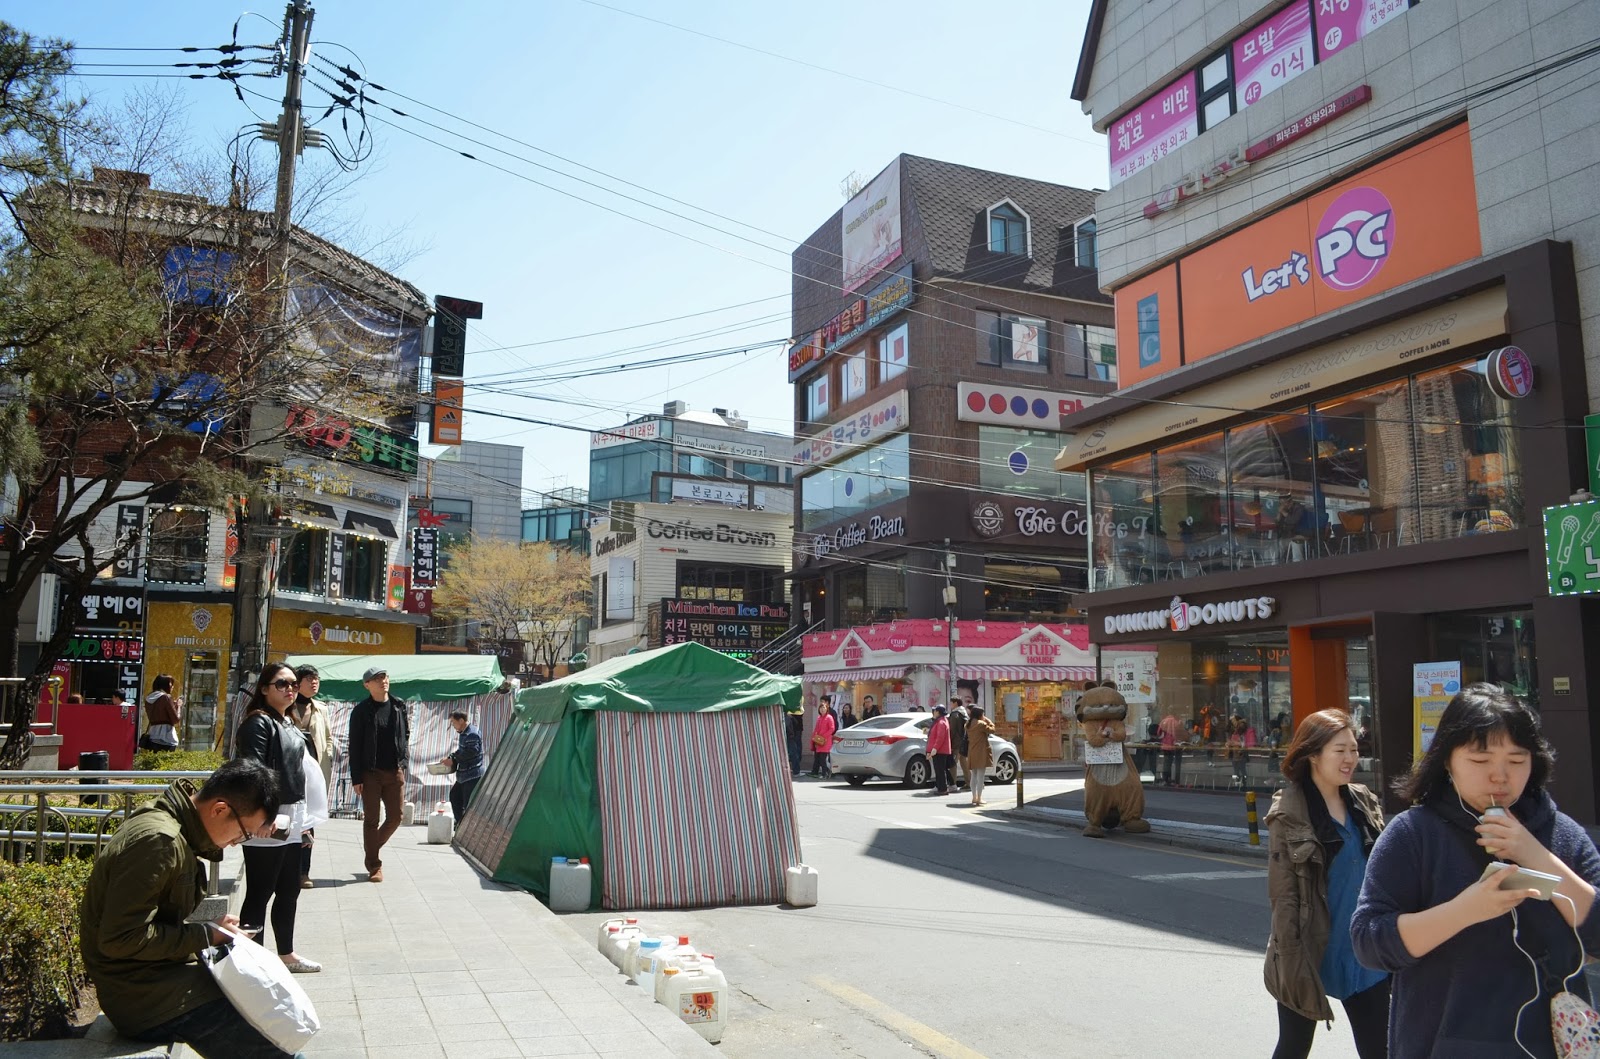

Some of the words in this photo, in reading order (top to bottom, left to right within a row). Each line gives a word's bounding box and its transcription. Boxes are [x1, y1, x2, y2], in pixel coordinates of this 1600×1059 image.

[1242, 27, 1275, 62] 모발
[1326, 29, 1340, 46] 4F
[1271, 47, 1304, 78] 이식
[1246, 84, 1259, 101] 4F
[1118, 125, 1145, 151] 제모
[1162, 85, 1189, 114] 비만
[1242, 251, 1310, 302] Let's
[1315, 208, 1391, 278] PC
[1399, 345, 1424, 359] COFFEE
[1430, 338, 1451, 350] MORE
[1270, 388, 1290, 400] COFFEE
[1294, 382, 1311, 393] MORE
[1184, 417, 1199, 429] MORE
[692, 485, 734, 501] 본로고스
[1014, 506, 1056, 536] The
[648, 517, 713, 541] Coffee
[716, 523, 776, 547] Brown
[834, 522, 866, 551] Coffee
[869, 515, 904, 540] Bean
[418, 528, 434, 581] 누벨헤어
[595, 535, 616, 557] Coffee
[1562, 577, 1573, 587] B1
[61, 594, 143, 620] 벨헤어
[737, 603, 759, 617] Ice
[759, 604, 788, 618] Pub
[664, 618, 687, 633] 치킨
[717, 624, 749, 637] 아이스
[1104, 608, 1170, 635] DUNKIN'
[1020, 643, 1061, 656] ETUDE
[1026, 656, 1055, 664] HOUSE
[1416, 671, 1429, 680] 모닝
